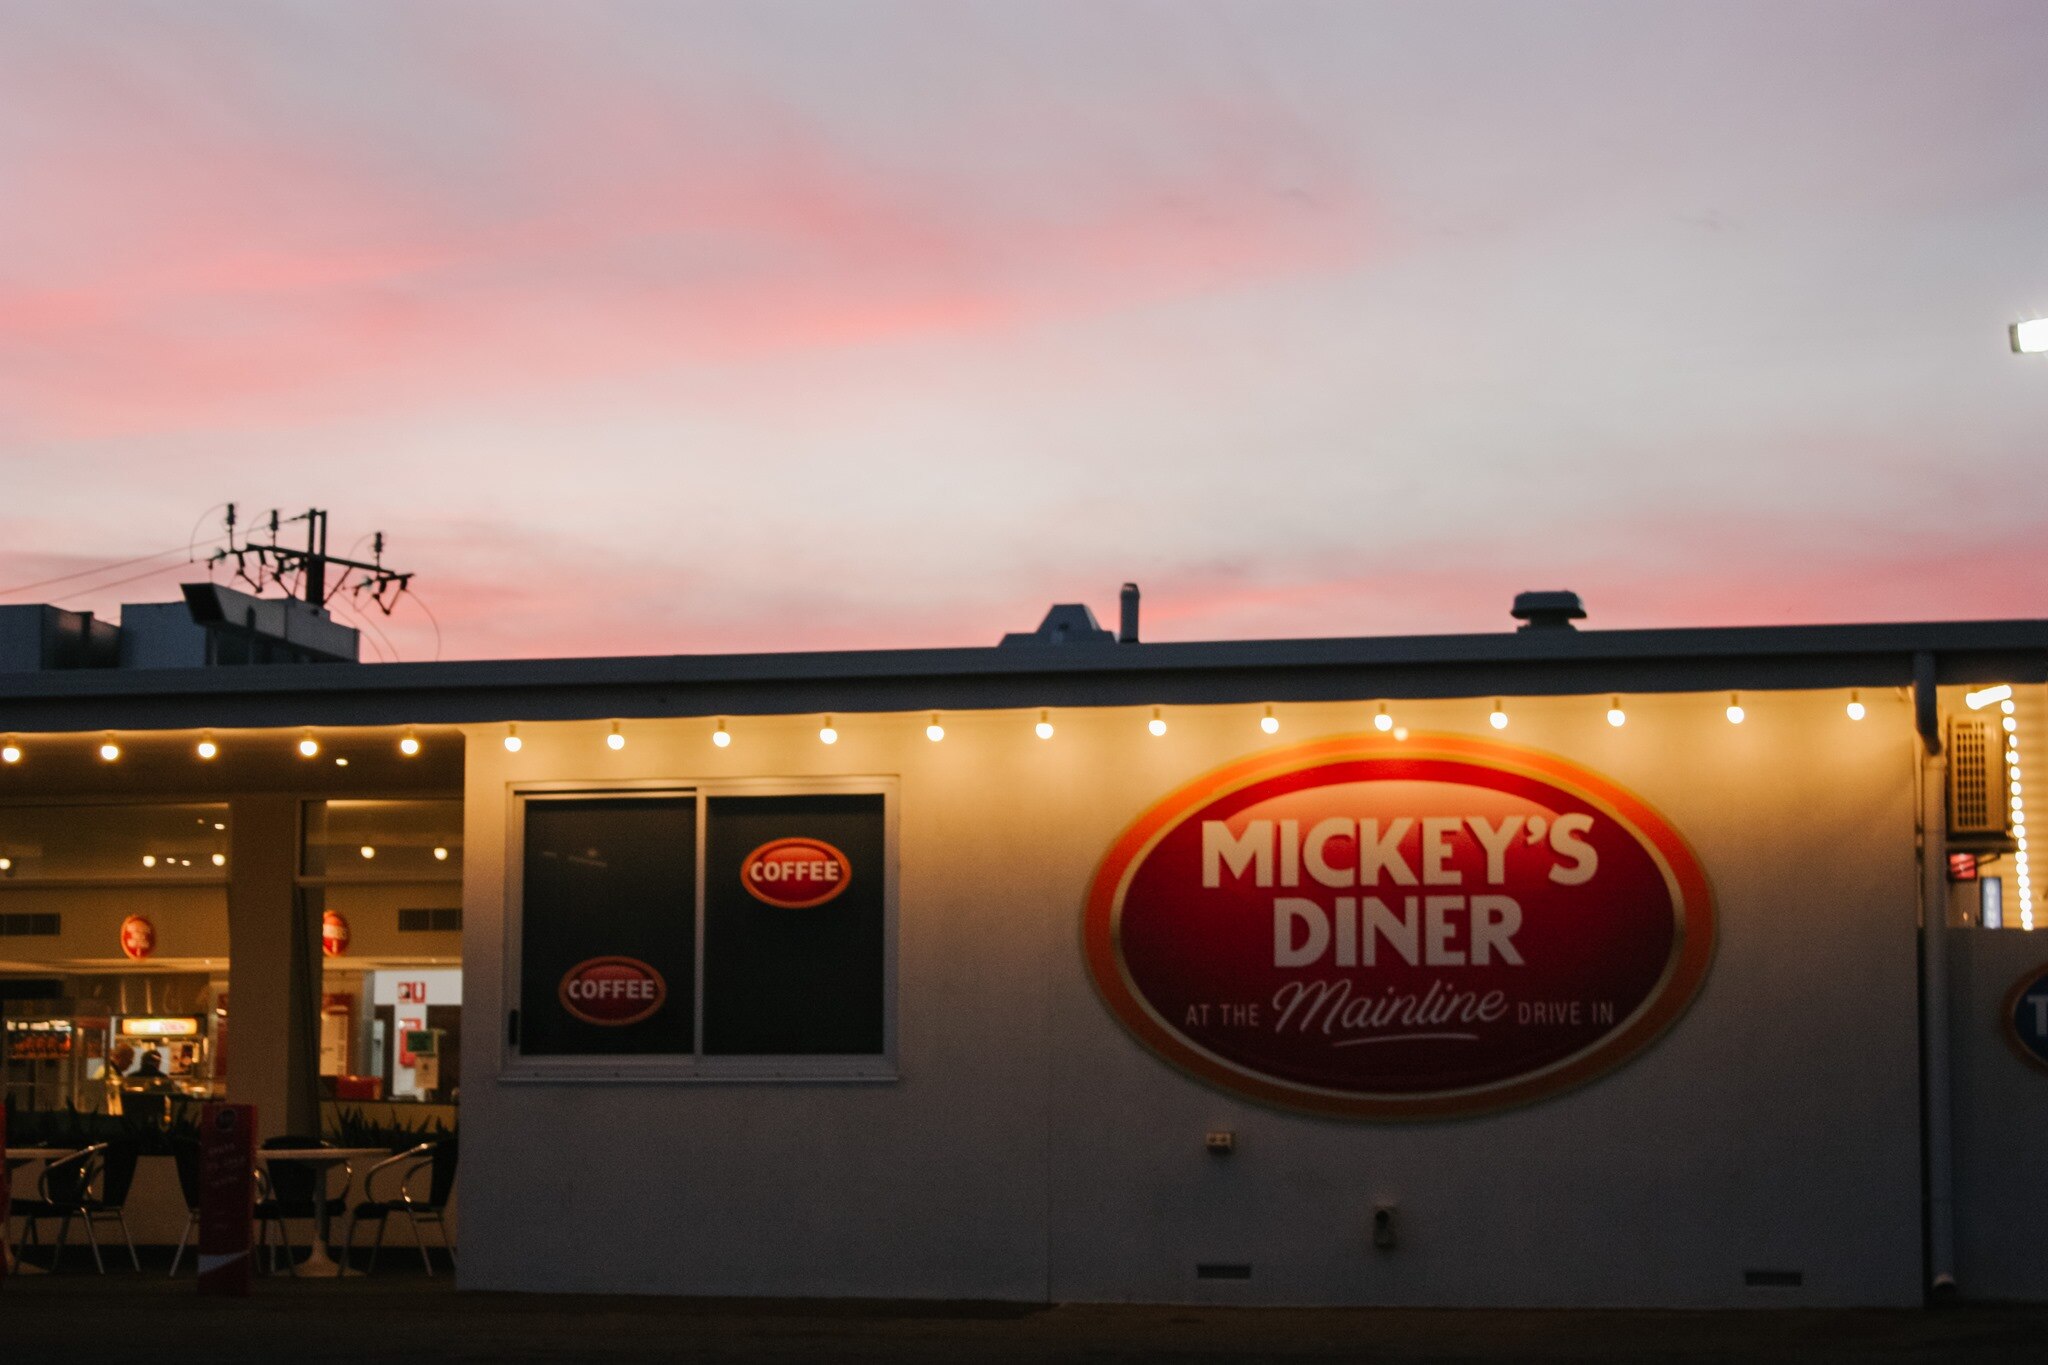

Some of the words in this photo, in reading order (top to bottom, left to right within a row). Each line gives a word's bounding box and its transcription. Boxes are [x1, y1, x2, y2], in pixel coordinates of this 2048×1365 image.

[750, 860, 839, 882] COFFEE
[1201, 813, 1599, 888] MICKEY'S
[1273, 895, 1526, 967] DINER
[567, 978, 655, 1000] COFFEE
[1185, 1003, 1210, 1026] AT
[1220, 1002, 1260, 1026] THE
[1271, 978, 1509, 1034] Mainline
[1518, 1001, 1582, 1025] DRIVE
[1592, 1001, 1615, 1025] IN
